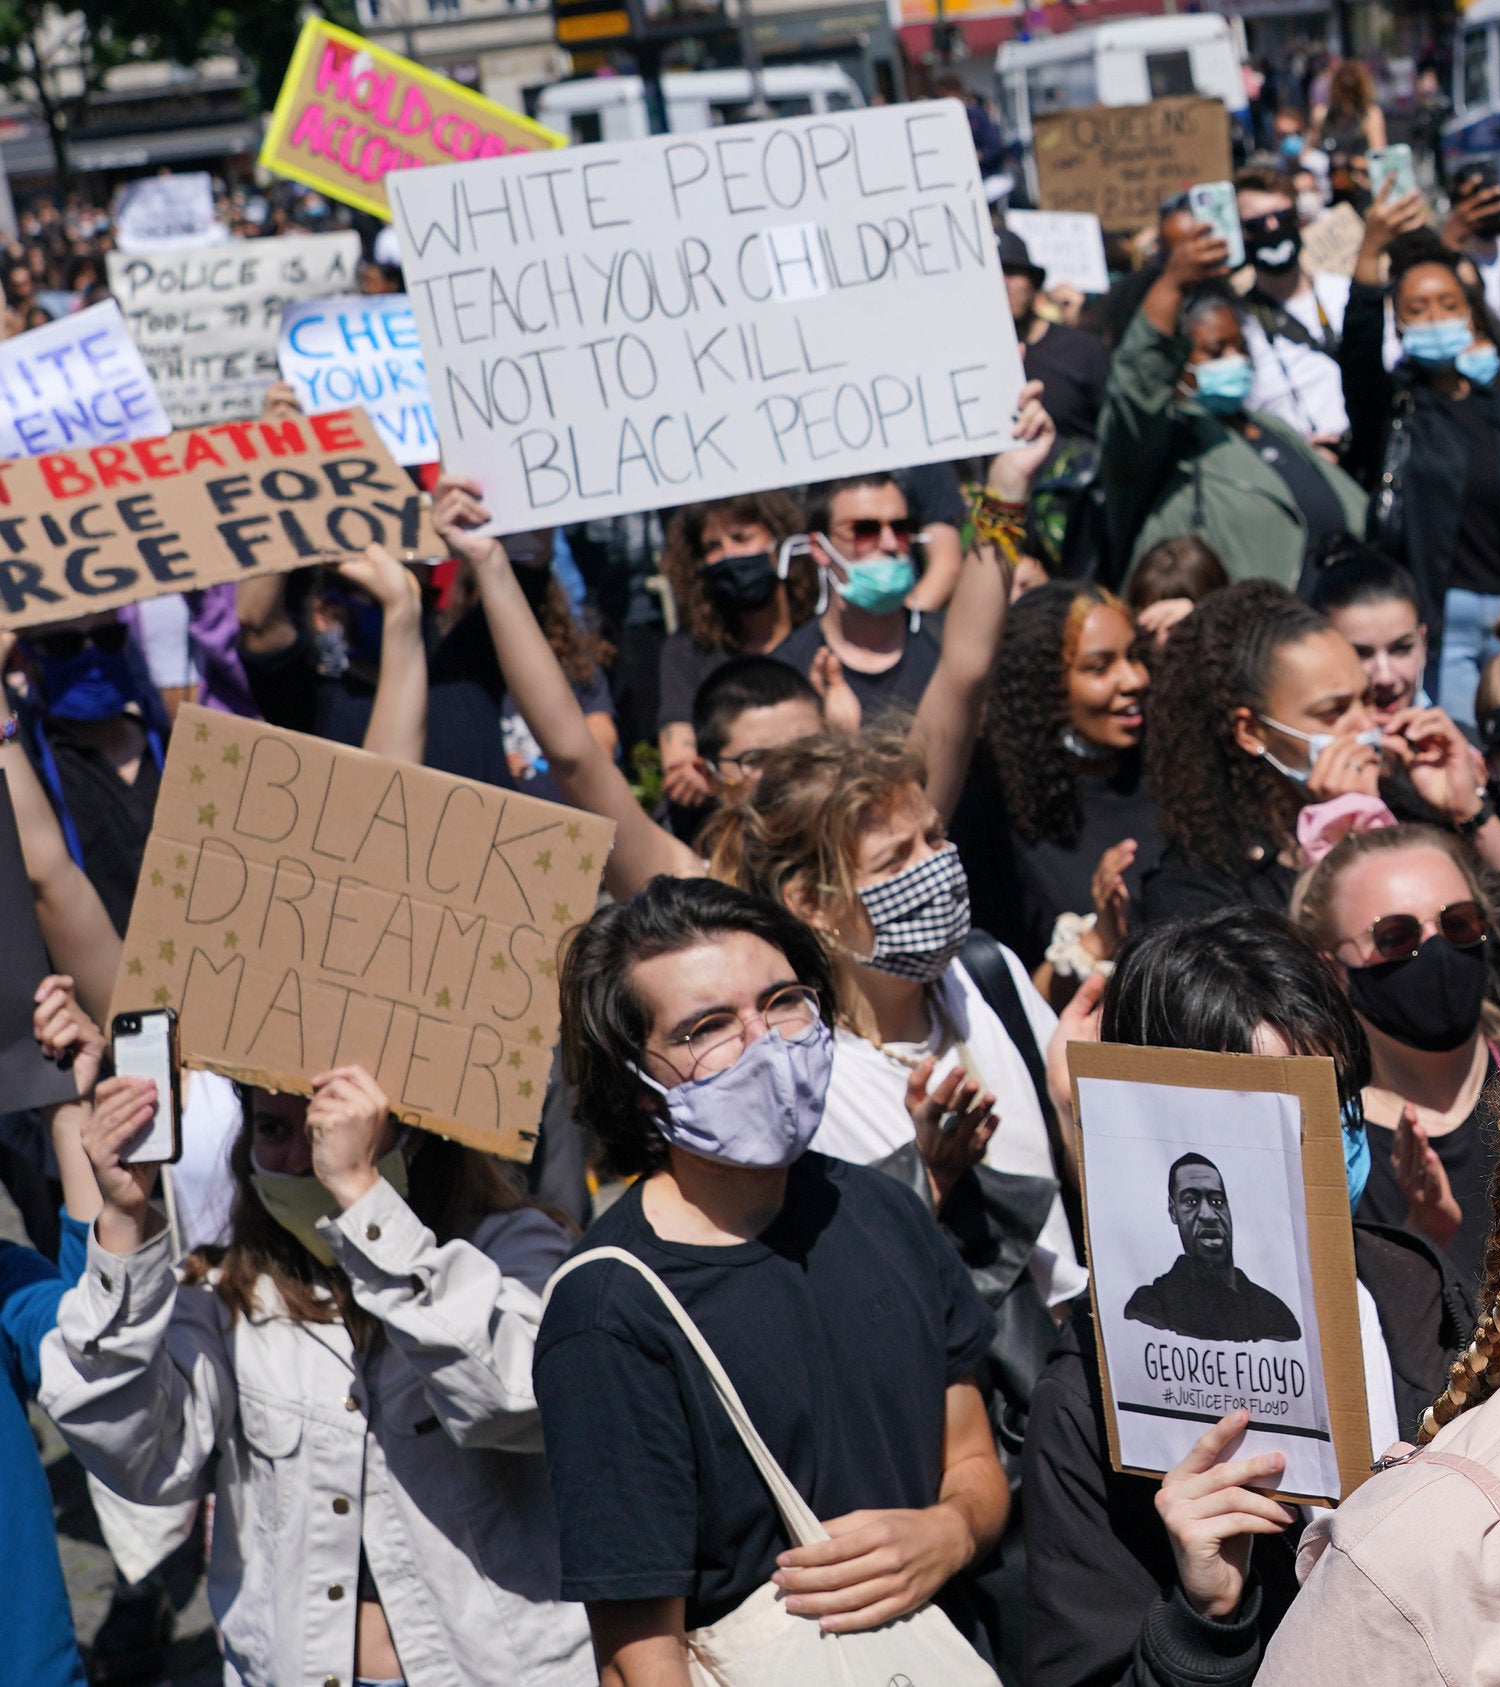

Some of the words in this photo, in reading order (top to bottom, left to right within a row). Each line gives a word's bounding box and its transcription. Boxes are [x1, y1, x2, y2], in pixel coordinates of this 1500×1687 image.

[315, 44, 432, 136] HOLD
[431, 112, 531, 162] COP
[395, 160, 632, 259] WHITE
[664, 112, 973, 220] PEOPLE,
[123, 259, 261, 299] POLICE
[325, 250, 347, 281] A
[737, 198, 986, 303] CHILDREN
[0, 328, 131, 408] ITE
[128, 309, 207, 339] TOOL
[288, 309, 420, 359] CHE
[0, 379, 152, 458] ENCE
[295, 359, 417, 406] YOUR
[446, 345, 567, 440] NOT
[578, 332, 659, 410] TO
[684, 315, 850, 394] KILL
[37, 409, 365, 501] BREATHE
[510, 411, 738, 509] BLACK
[756, 363, 999, 464] PEOPLE
[0, 493, 165, 554] TICE
[205, 457, 397, 515] FOR
[0, 533, 195, 614] RGE
[216, 496, 420, 568] FLOY
[233, 734, 564, 922] BLACK
[185, 836, 546, 1022] DREAMS
[179, 946, 504, 1130] MATTER
[1144, 1342, 1229, 1387] GEORGE
[1236, 1351, 1305, 1398] FLOYD
